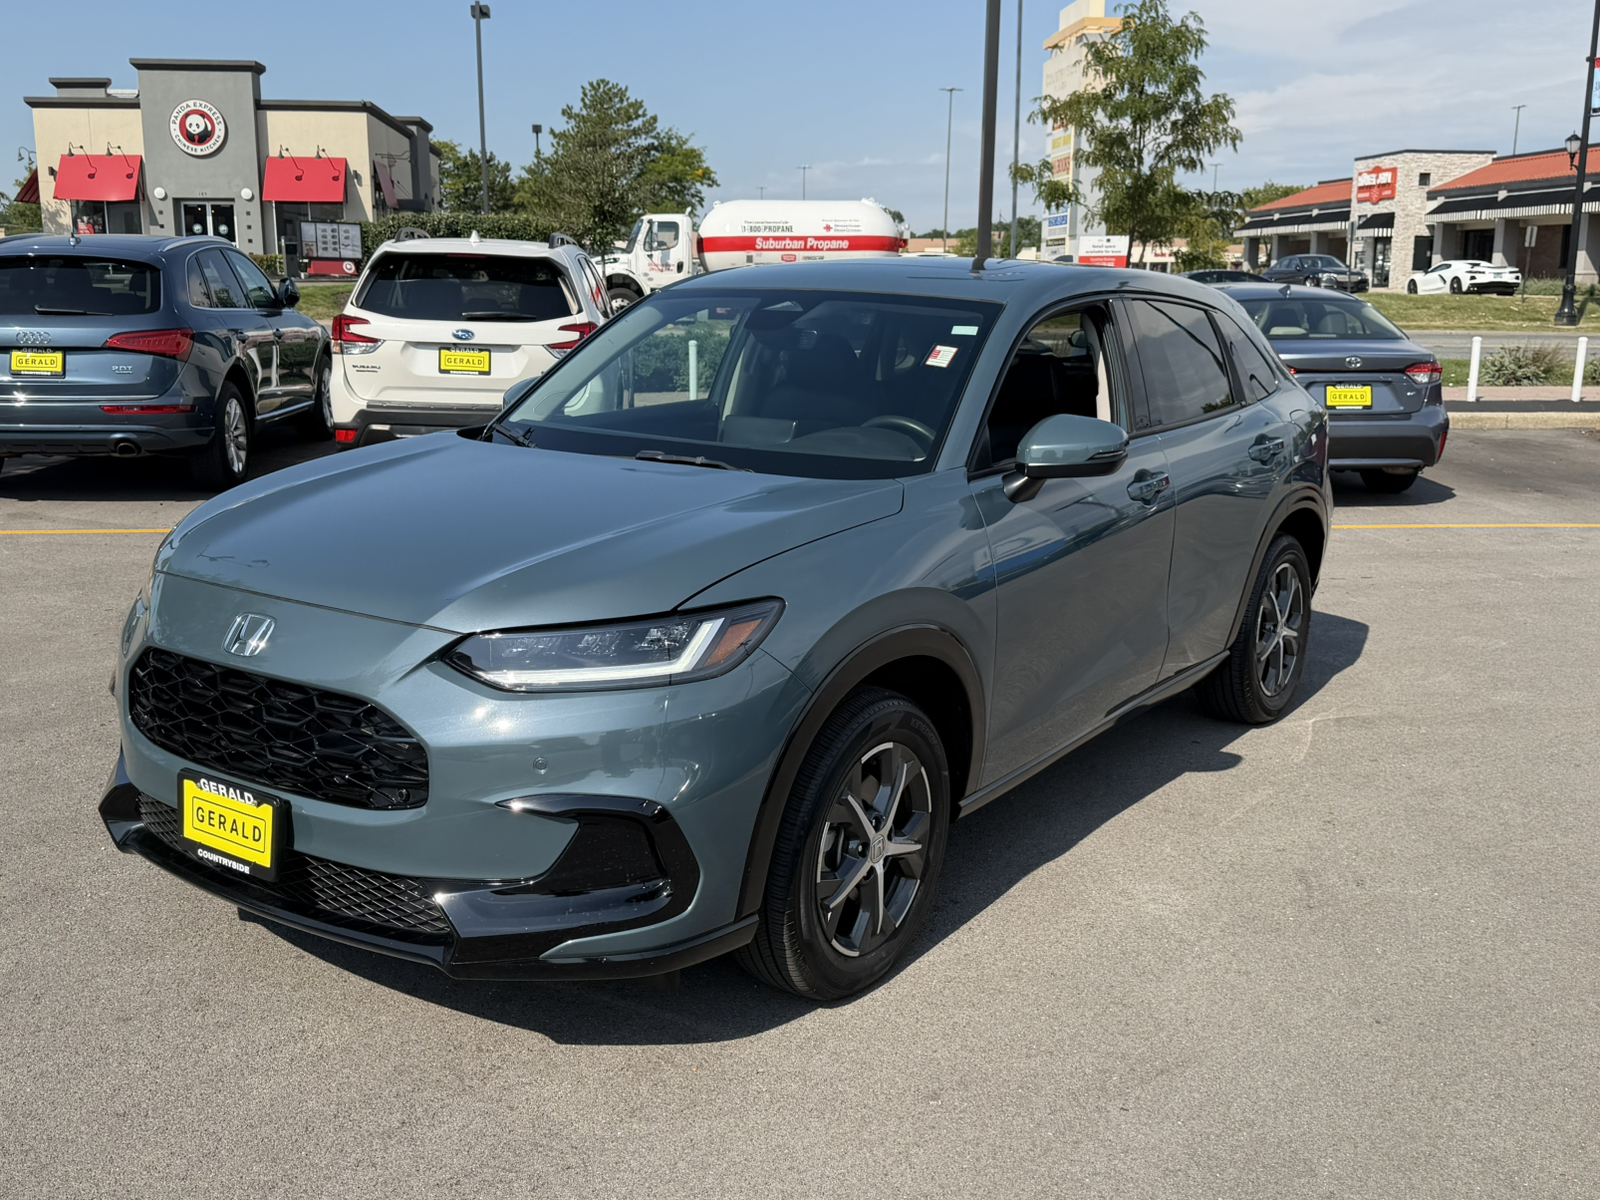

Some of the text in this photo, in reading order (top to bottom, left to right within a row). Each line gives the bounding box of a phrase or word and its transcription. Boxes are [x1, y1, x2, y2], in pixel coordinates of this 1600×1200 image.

[172, 102, 222, 126] PANDA EXPRESS
[175, 134, 221, 153] CHINESE KITCHEN
[755, 237, 849, 251] Suburban Propane
[18, 358, 56, 366] GERALD
[446, 357, 483, 366] GERALD
[200, 778, 254, 805] GERALD
[196, 806, 262, 842] GERALD
[197, 848, 250, 874] COUNTRYSIDE
